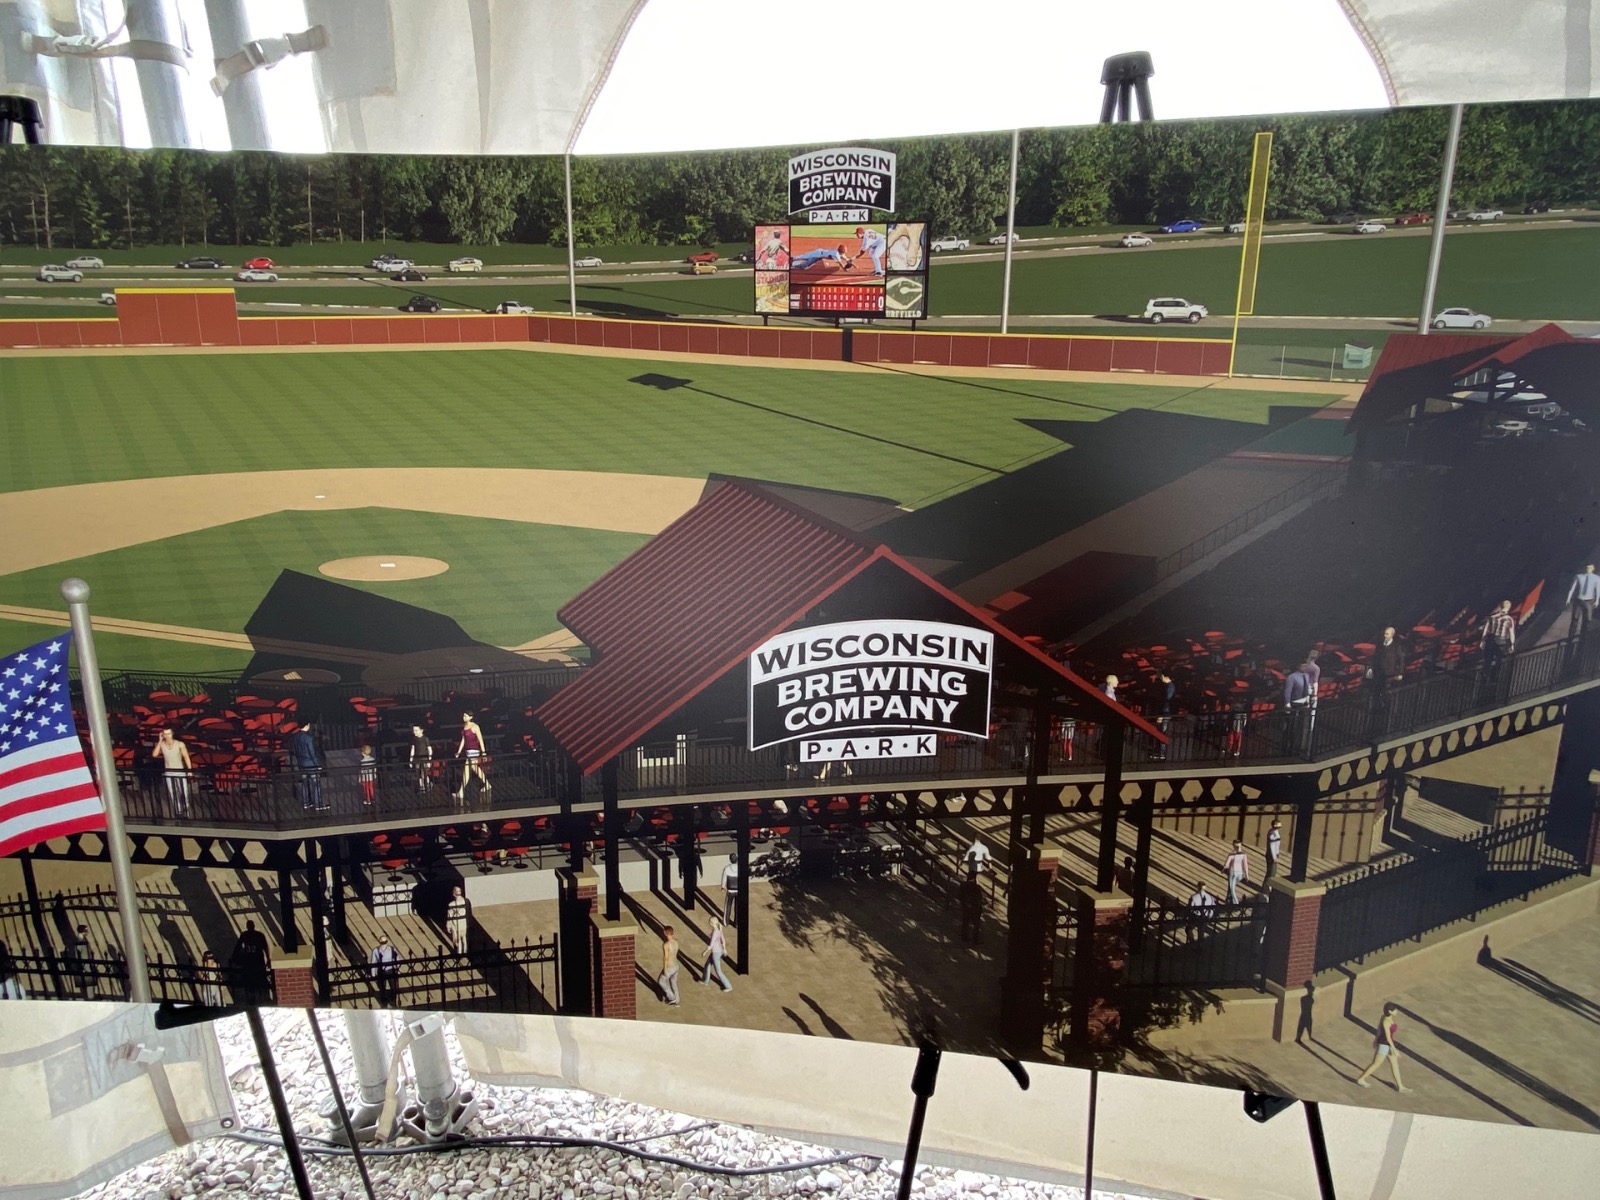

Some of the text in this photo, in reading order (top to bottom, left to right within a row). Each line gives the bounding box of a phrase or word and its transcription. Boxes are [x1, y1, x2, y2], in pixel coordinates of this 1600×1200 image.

[791, 153, 891, 175] WISCONSIN
[799, 171, 882, 193] BREWING
[802, 187, 878, 206] COMPANY
[757, 632, 988, 675] WISCONSIN
[777, 666, 968, 708] BREWING
[784, 695, 959, 731] COMPANY
